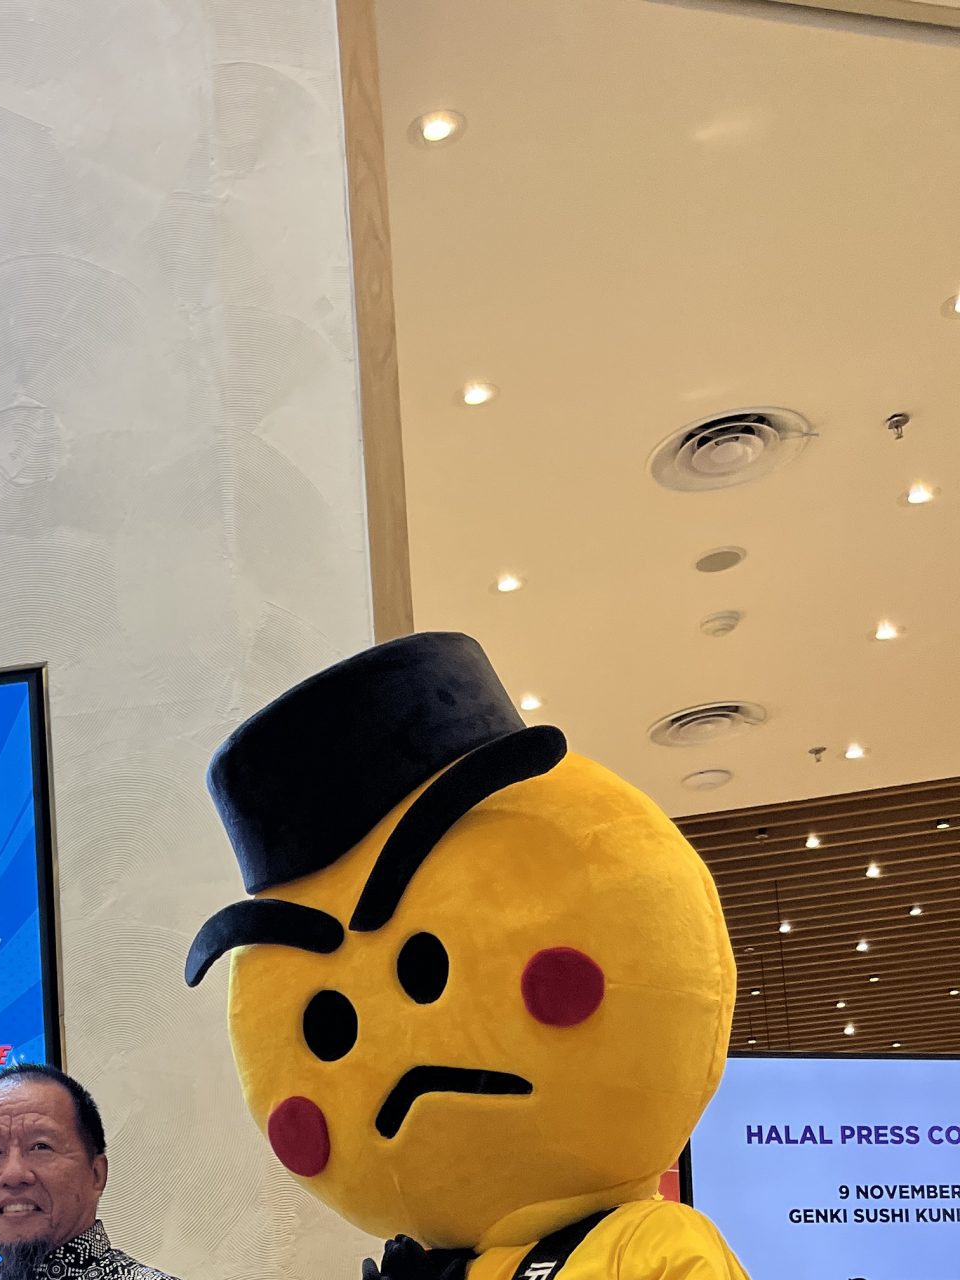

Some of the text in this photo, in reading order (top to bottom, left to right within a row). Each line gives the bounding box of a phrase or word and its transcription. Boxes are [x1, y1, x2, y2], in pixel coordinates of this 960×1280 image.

[746, 1125, 960, 1145] HALAL PRESS CO
[839, 1184, 960, 1200] 9 NOVEMBER
[789, 1208, 848, 1224] GENKI
[854, 1208, 910, 1224] SUSHI
